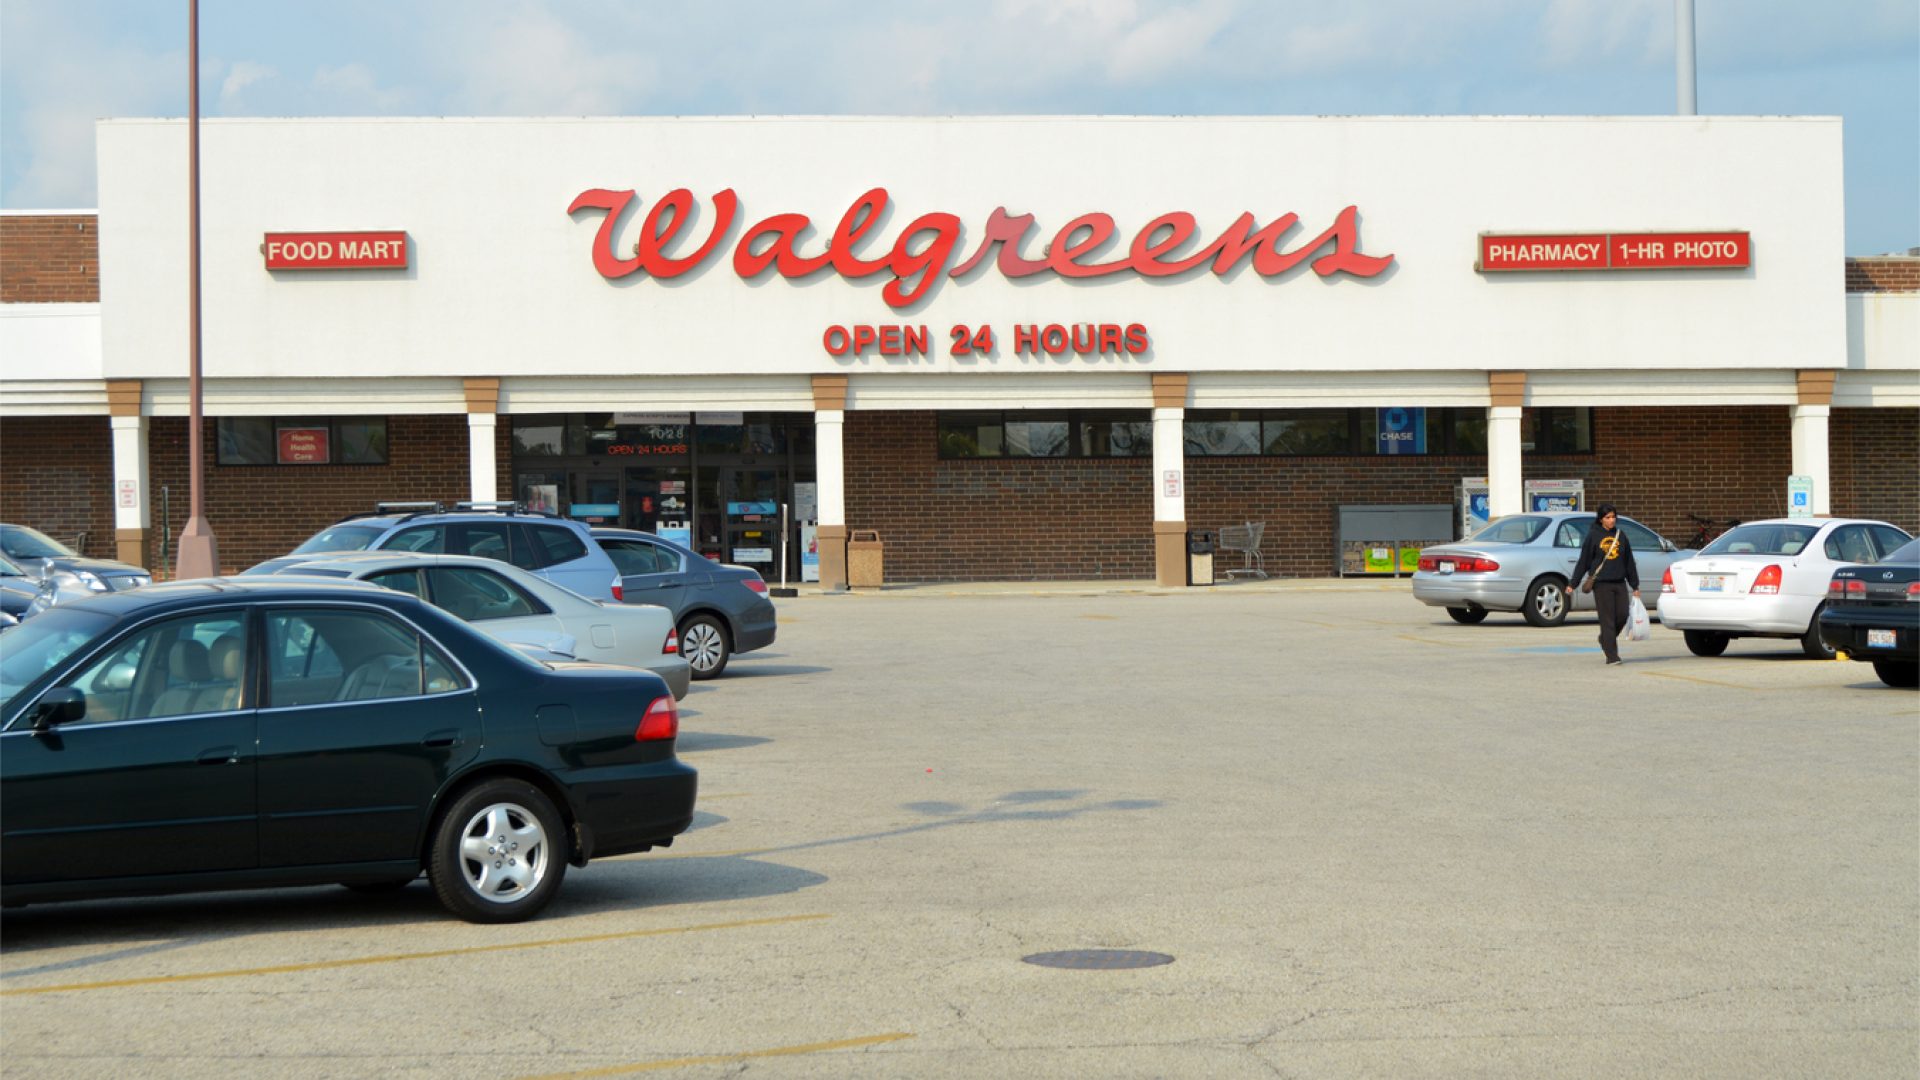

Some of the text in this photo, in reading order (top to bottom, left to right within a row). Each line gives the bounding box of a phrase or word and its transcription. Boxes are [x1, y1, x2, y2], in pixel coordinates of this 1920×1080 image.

[268, 240, 403, 261] FOOD MART
[567, 187, 1395, 308] Walgreens
[1489, 243, 1601, 262] PHARMACY
[1619, 240, 1739, 260] 1-HR PHOTO
[823, 323, 1149, 356] OPEN 24 HOURS
[291, 433, 315, 441] Home
[649, 428, 684, 439] 1028
[1380, 432, 1414, 441] CHASE
[290, 443, 317, 451] Health
[607, 444, 688, 455] OPEN 24 HOURS
[294, 453, 313, 461] Care
